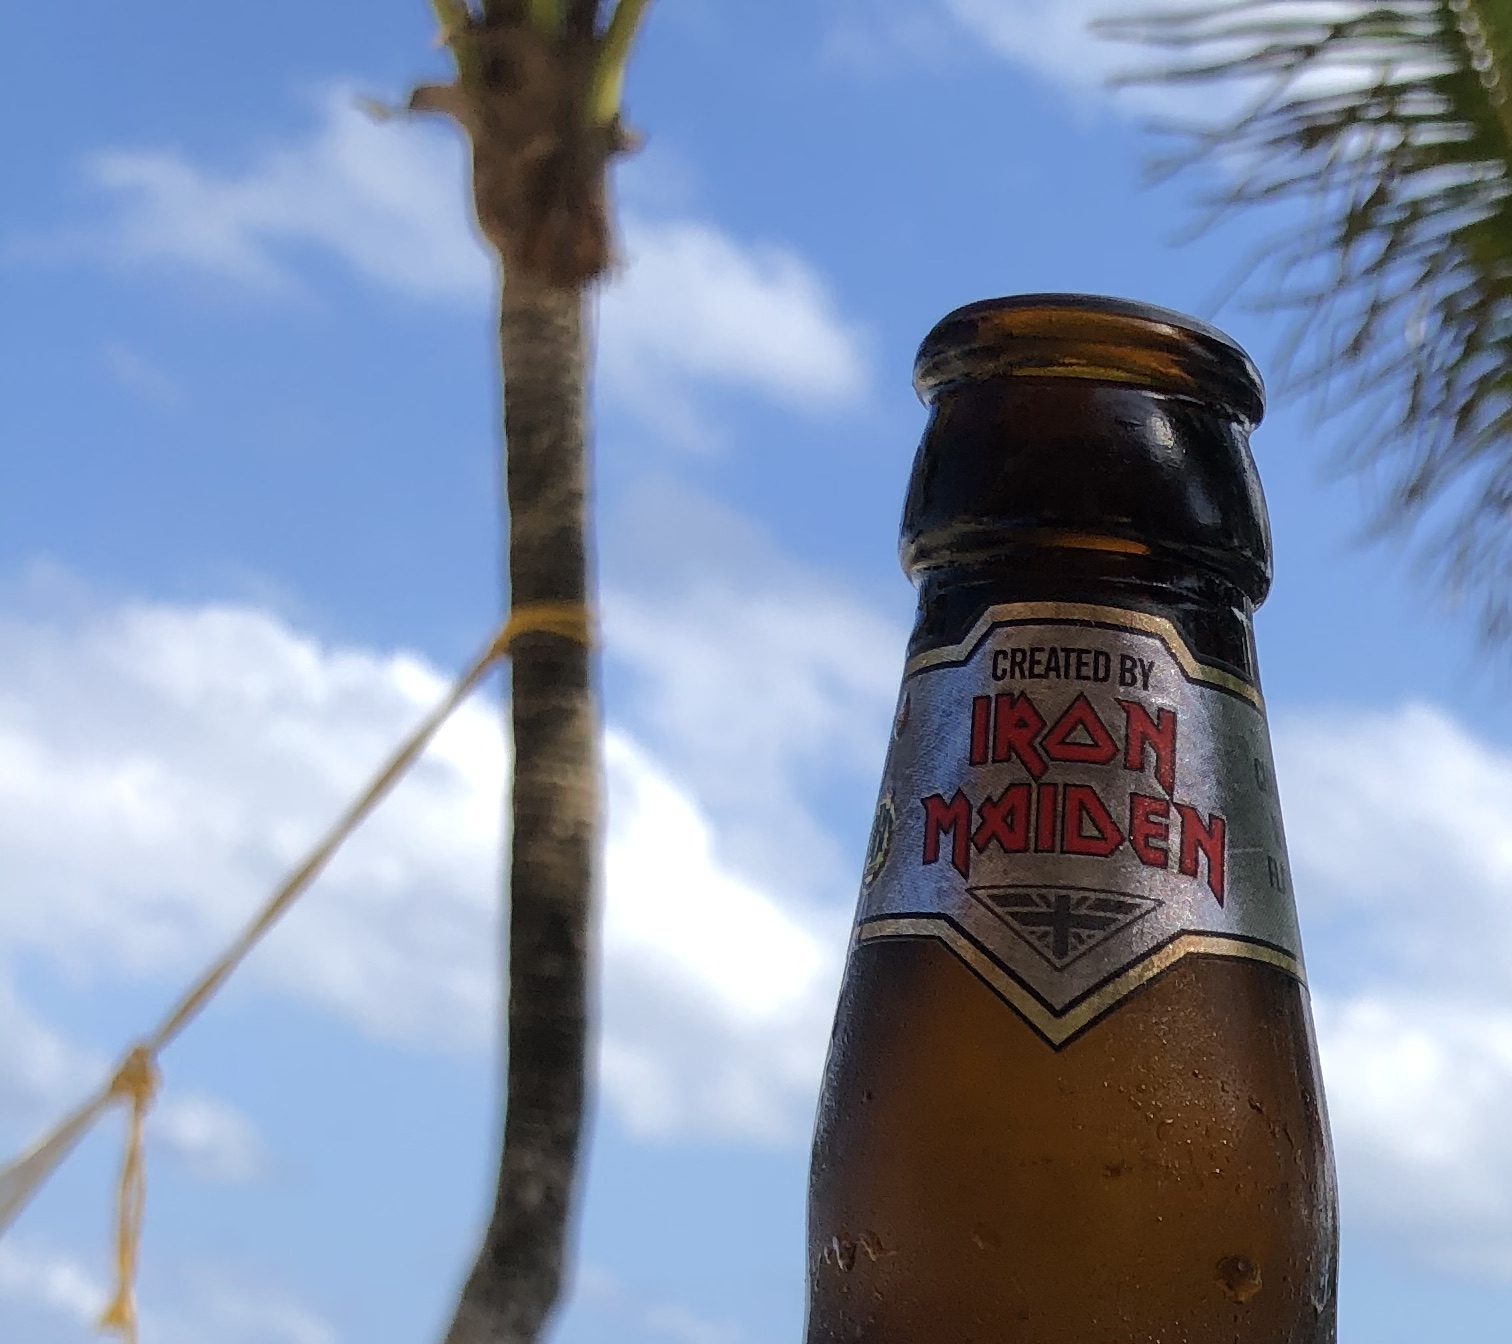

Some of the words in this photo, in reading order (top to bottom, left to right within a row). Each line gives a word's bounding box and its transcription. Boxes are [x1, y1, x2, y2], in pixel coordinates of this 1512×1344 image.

[991, 646, 1111, 684] CREATED
[1119, 655, 1156, 691] BY
[969, 690, 1178, 799] IRON
[921, 782, 1227, 909] MAIDEN
